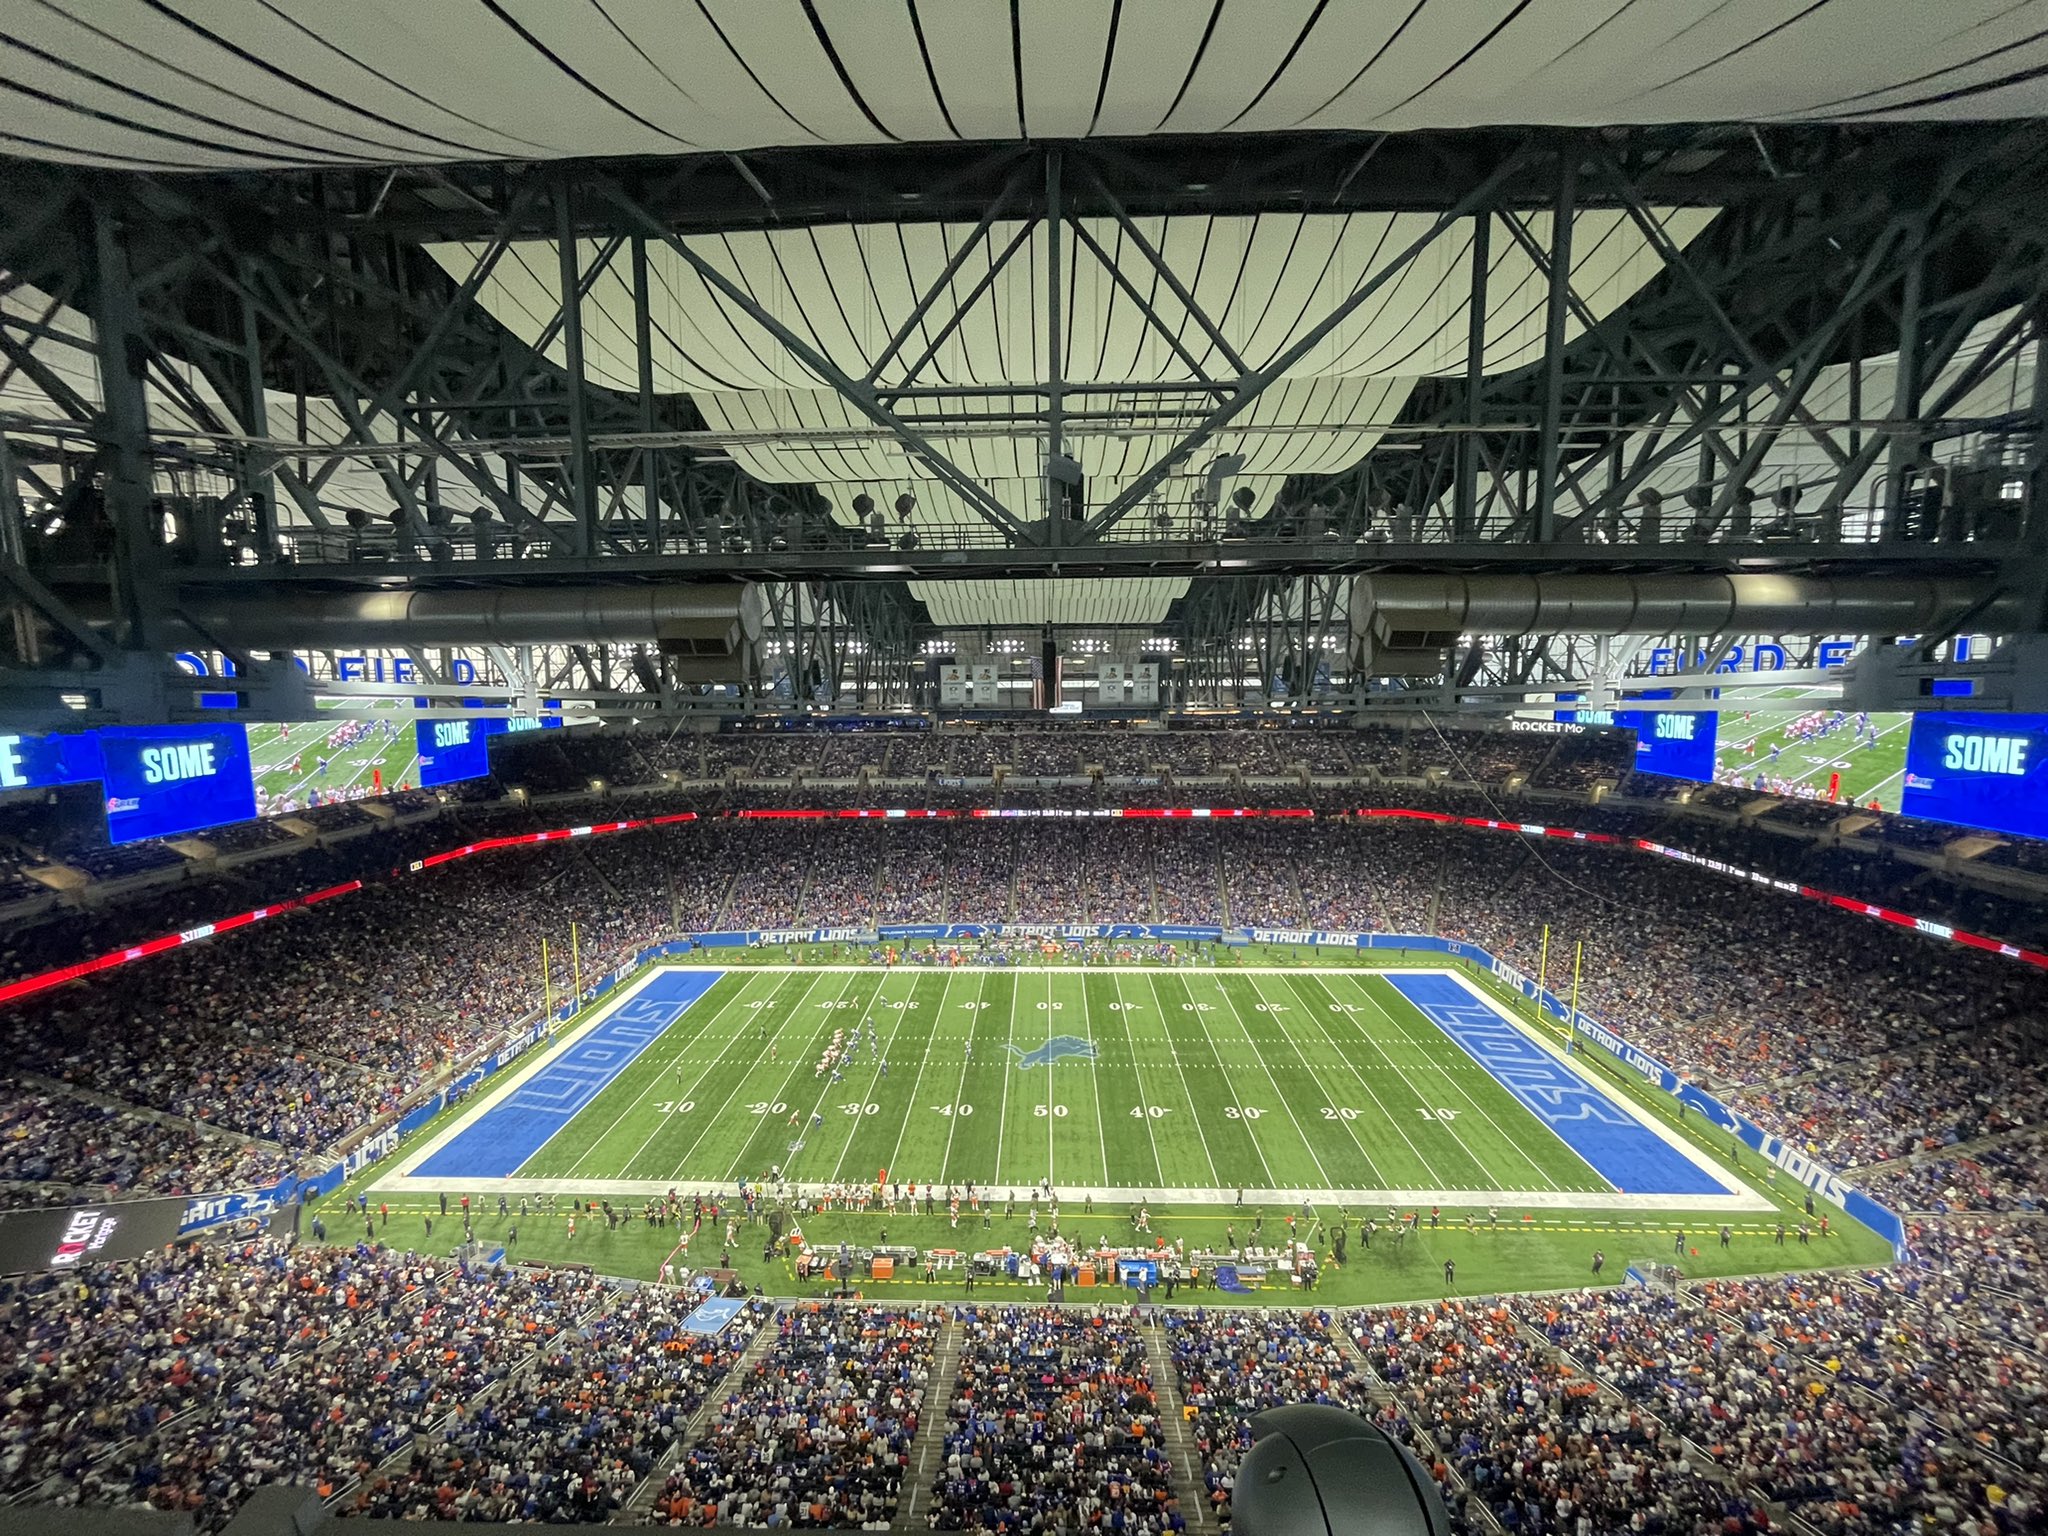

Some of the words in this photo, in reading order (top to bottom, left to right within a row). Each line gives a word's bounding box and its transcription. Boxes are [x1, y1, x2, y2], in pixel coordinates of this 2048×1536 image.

[338, 657, 476, 688] FIED
[435, 721, 470, 748] SOME
[1512, 721, 1563, 733] ROCKET
[1656, 713, 1696, 740] SOME
[143, 743, 217, 783] SOME
[1945, 734, 2029, 775] SOME
[1253, 930, 1312, 944] DETROIT
[1316, 932, 1359, 946] LIONS
[1491, 958, 1526, 993] LIONS
[1577, 1017, 1623, 1055] DETROIT
[1625, 1048, 1663, 1083] LIONS
[1033, 1105, 1068, 1117] 50
[1758, 1134, 1853, 1210] LIONS
[51, 1210, 100, 1264] ROCKET
